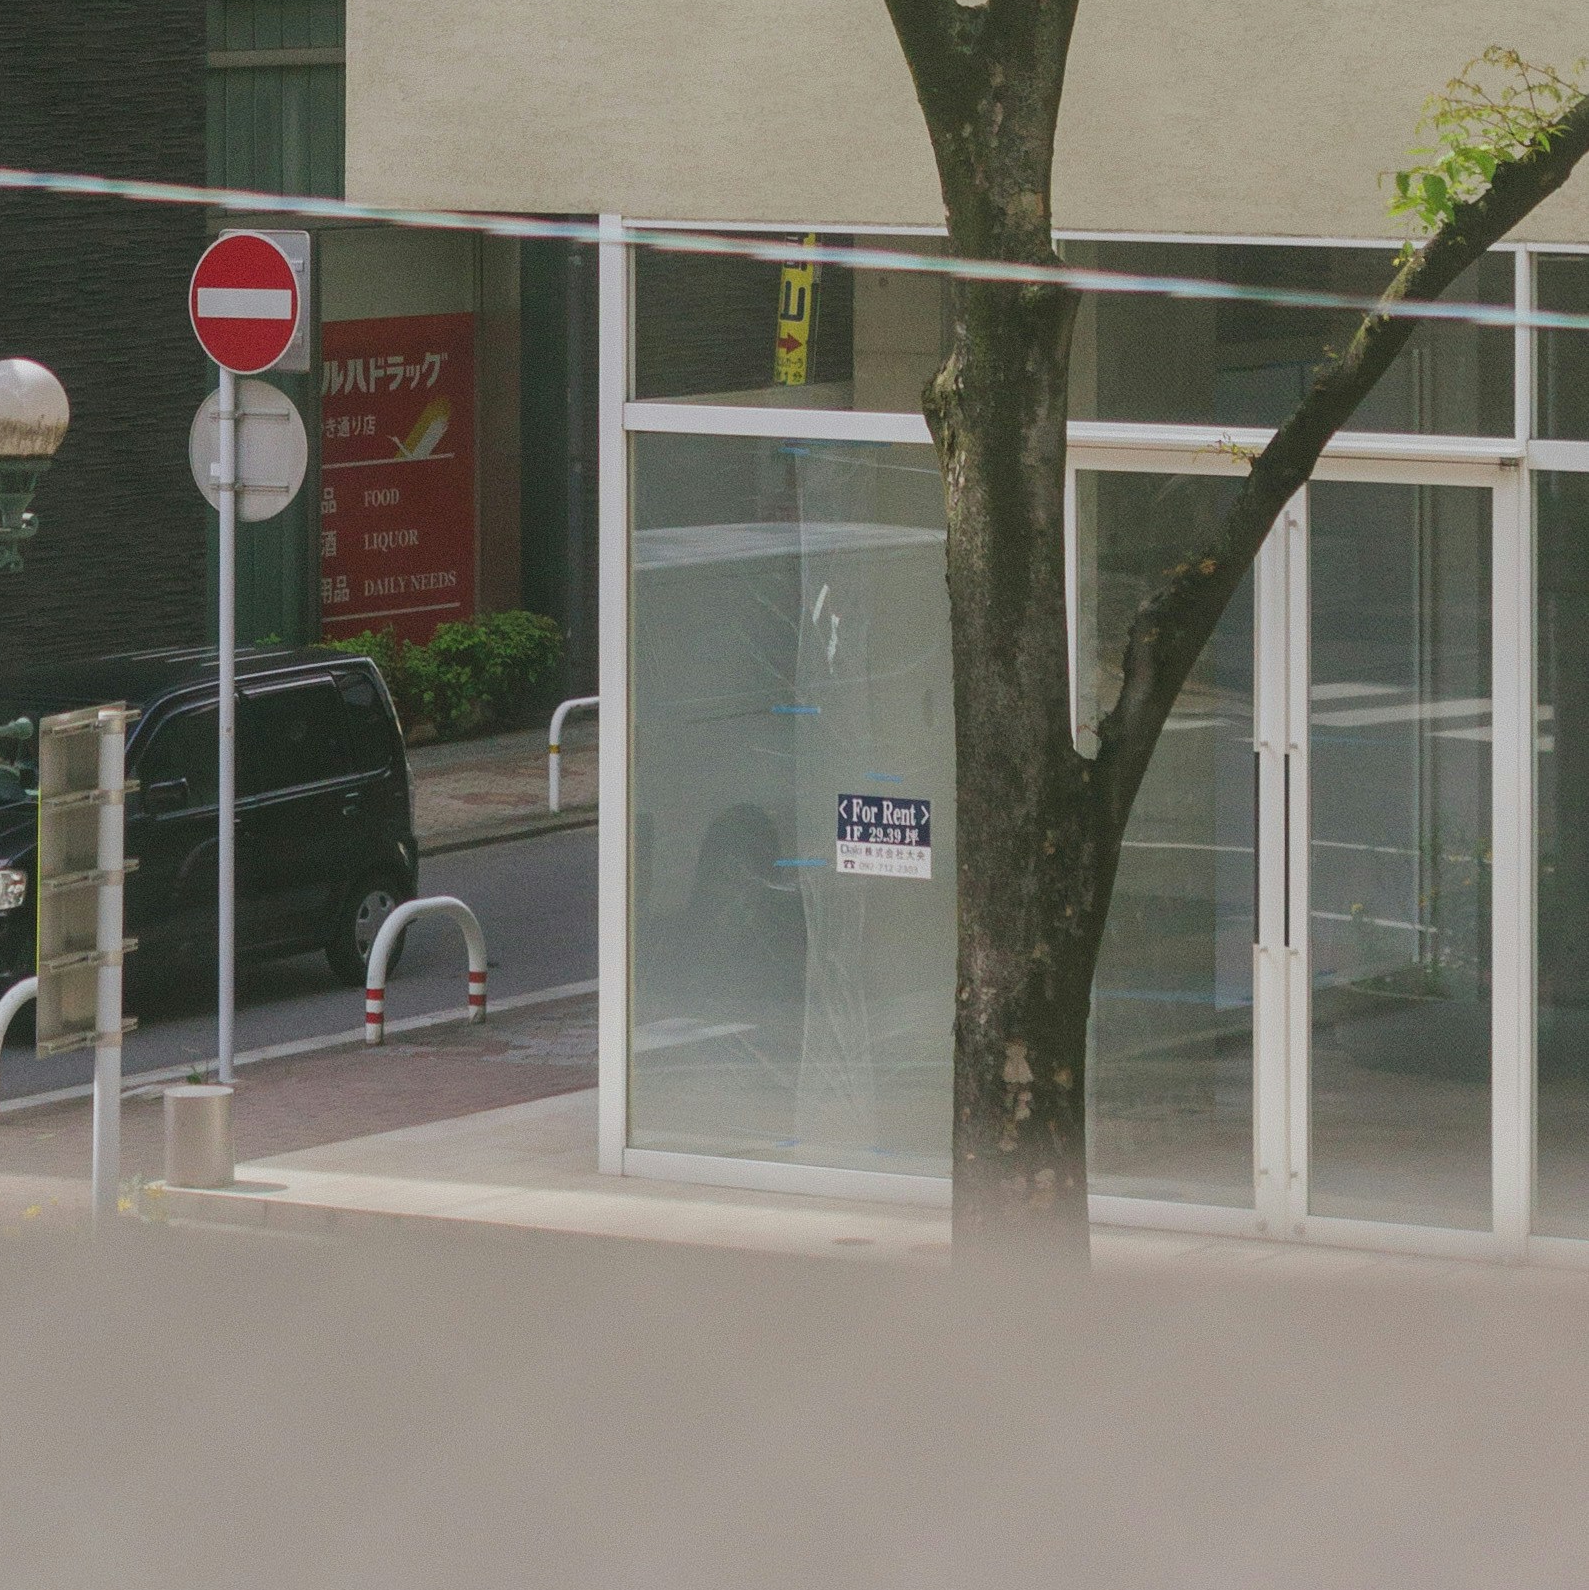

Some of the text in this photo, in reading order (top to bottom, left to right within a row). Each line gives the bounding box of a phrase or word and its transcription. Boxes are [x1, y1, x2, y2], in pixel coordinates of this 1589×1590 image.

[321, 415, 377, 438] き通り店
[364, 489, 399, 508] FOOD
[364, 529, 419, 552] LIQUOR
[364, 576, 408, 596] DAILY
[410, 571, 457, 591] NEEDS
[852, 799, 916, 826] For Rent
[845, 826, 863, 841] 1F
[869, 827, 901, 843] 29.39
